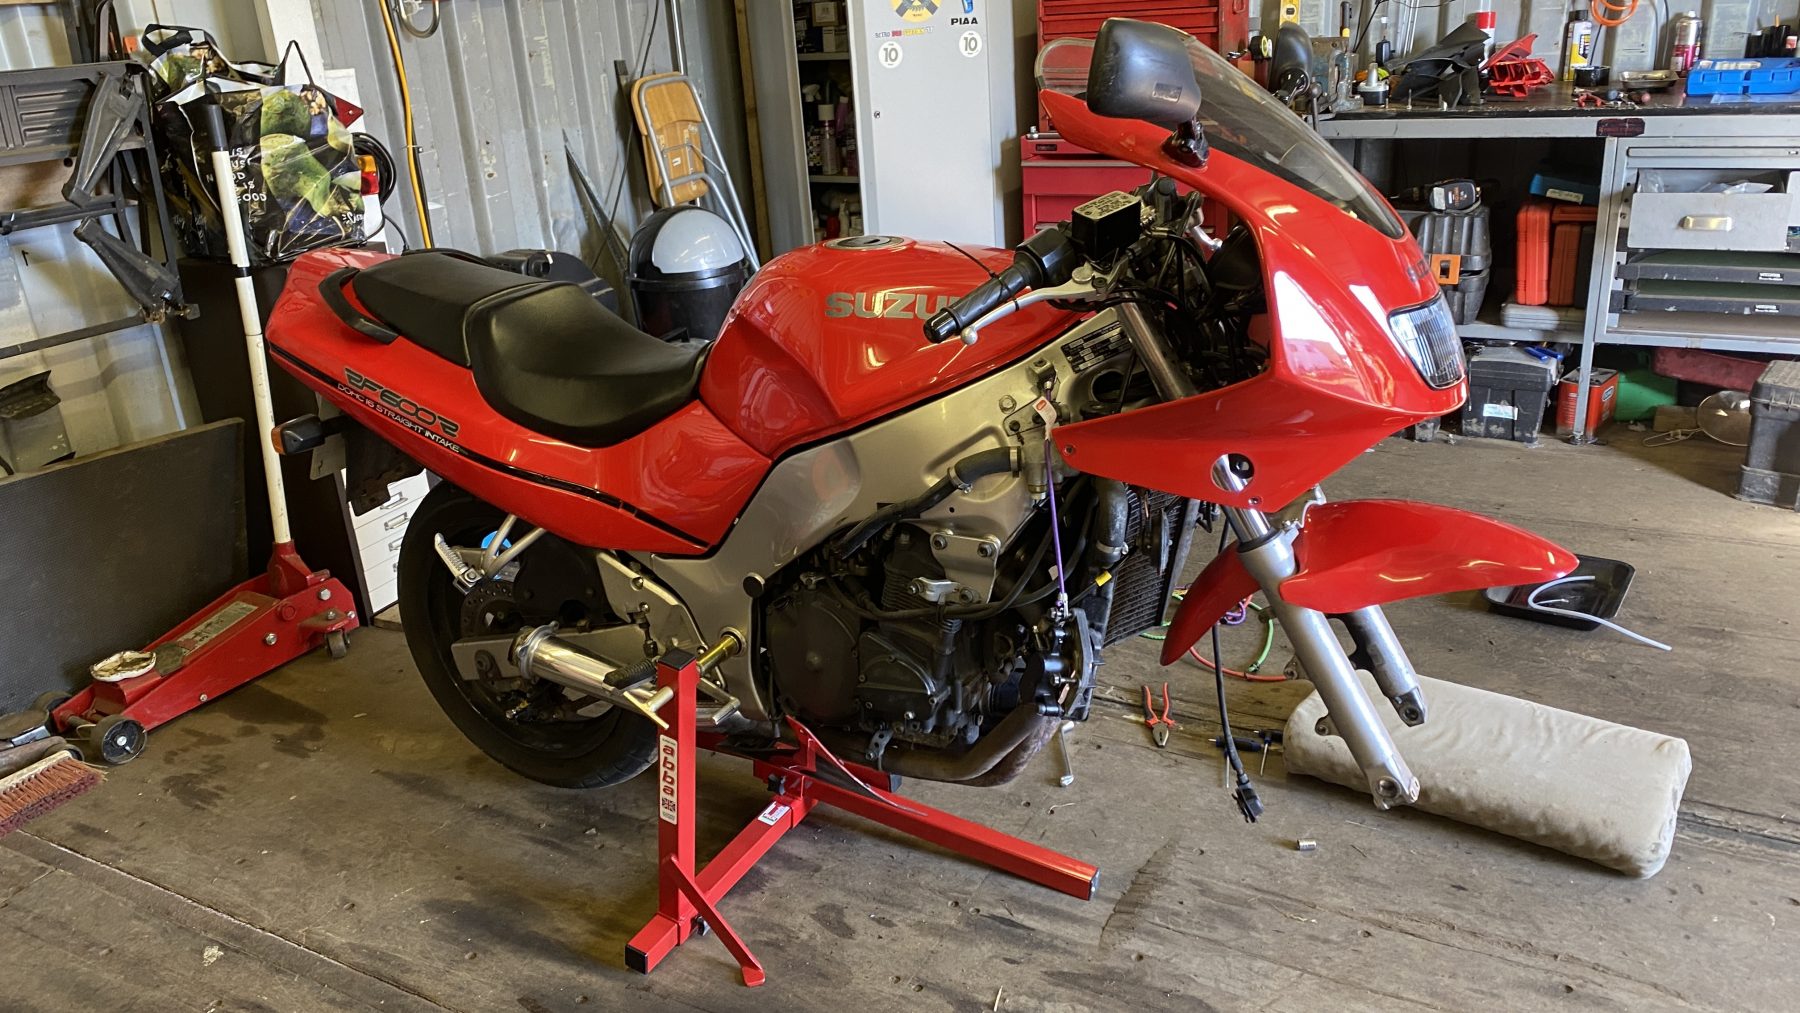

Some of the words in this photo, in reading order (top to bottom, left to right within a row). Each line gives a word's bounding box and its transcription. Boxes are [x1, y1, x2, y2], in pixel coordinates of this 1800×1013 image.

[950, 17, 978, 26] PIAA
[963, 36, 978, 52] 10
[883, 47, 898, 62] 10
[338, 383, 364, 402] DOHC
[365, 398, 376, 409] 16
[376, 405, 423, 434] STRAIGHT
[424, 432, 460, 453] INTAKE
[662, 744, 676, 797] abba
